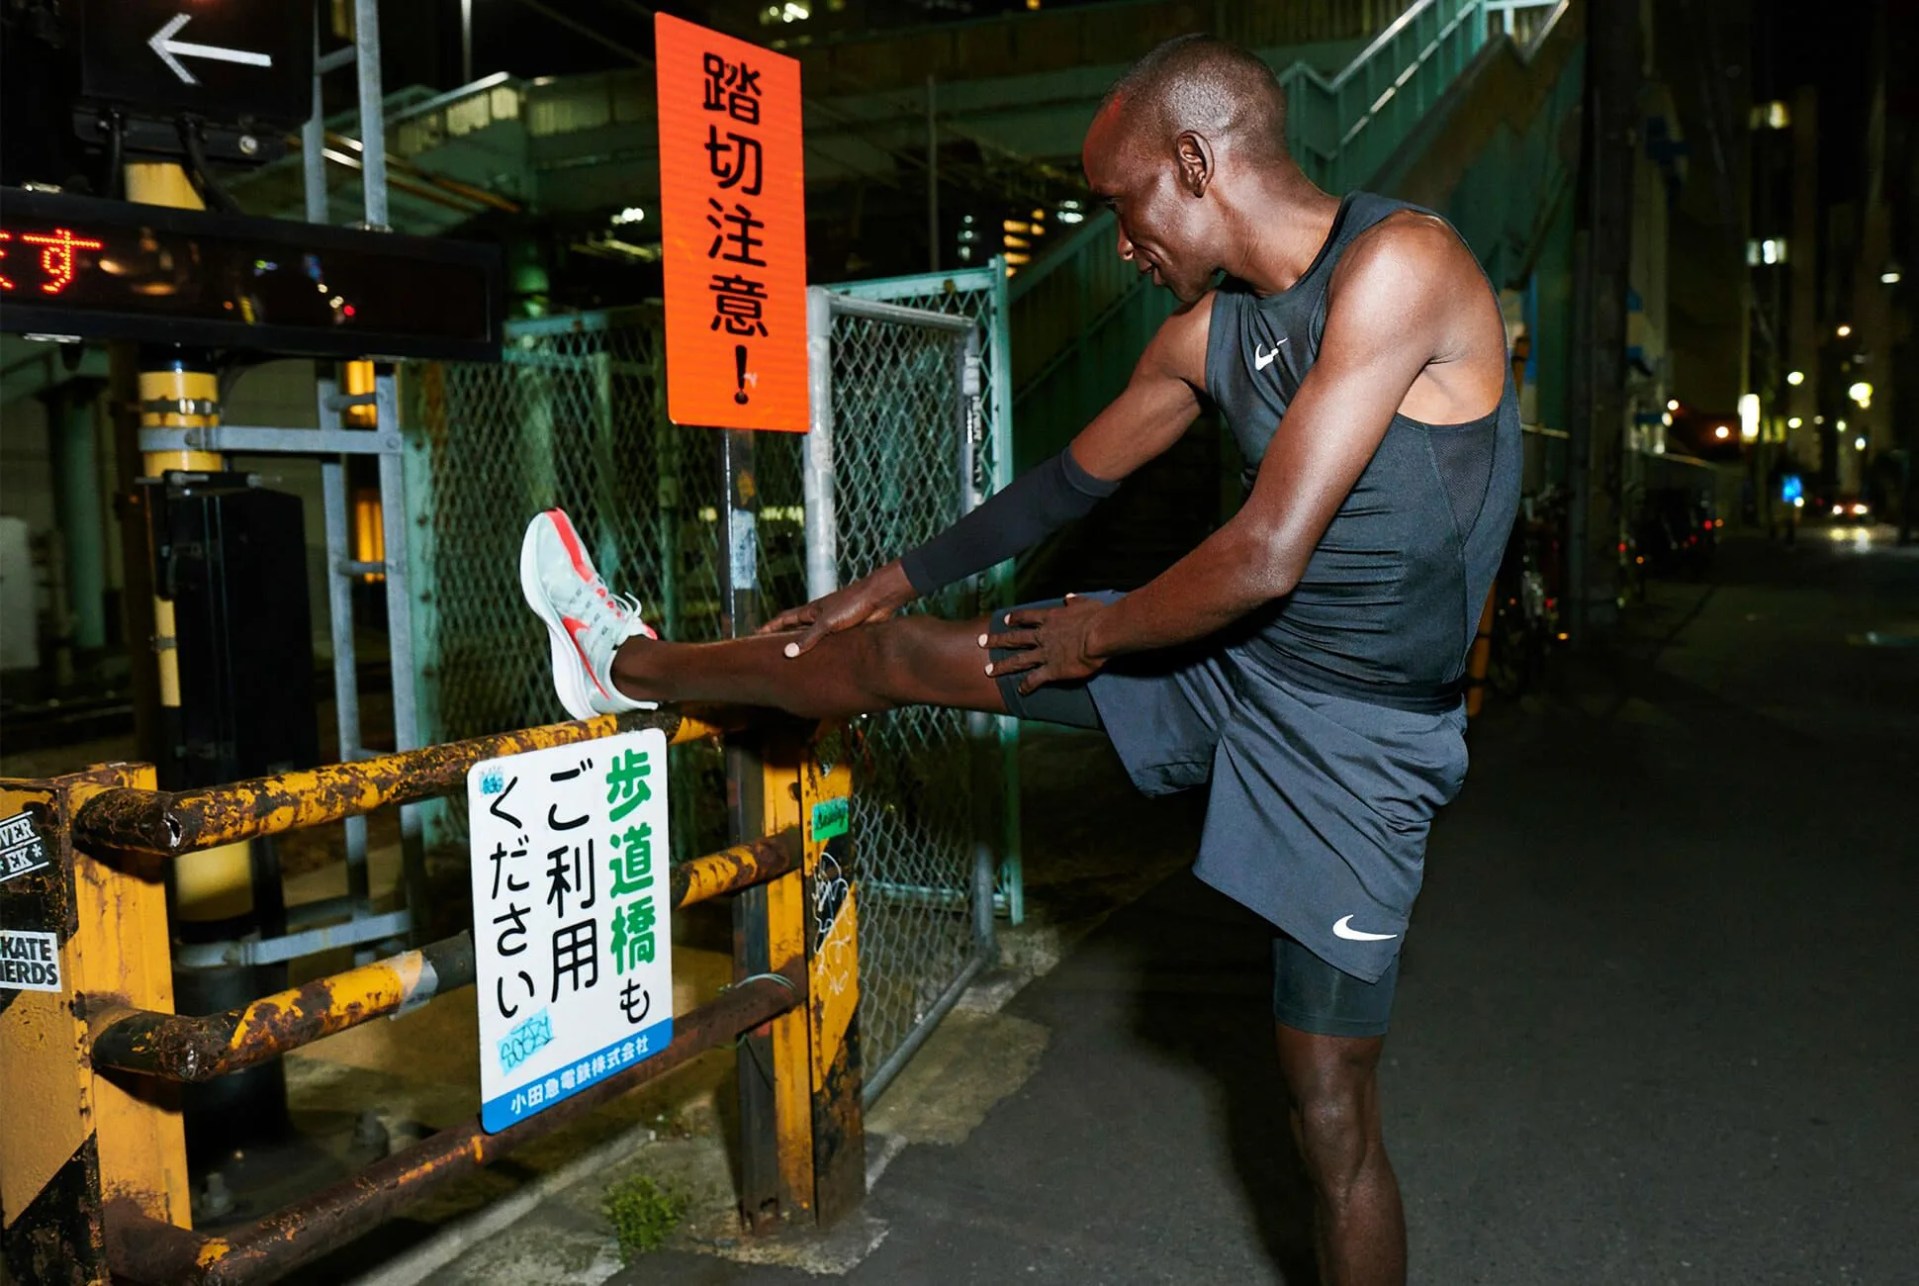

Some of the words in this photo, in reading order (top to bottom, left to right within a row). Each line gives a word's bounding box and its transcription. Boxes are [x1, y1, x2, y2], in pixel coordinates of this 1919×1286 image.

[0, 229, 101, 293] す
[702, 51, 768, 405] 踏切注意!
[0, 818, 36, 847] VER
[0, 936, 52, 962] KATE
[488, 776, 536, 1019] ください
[546, 757, 599, 1004] ご利用
[605, 748, 657, 1025] 歩道橋も
